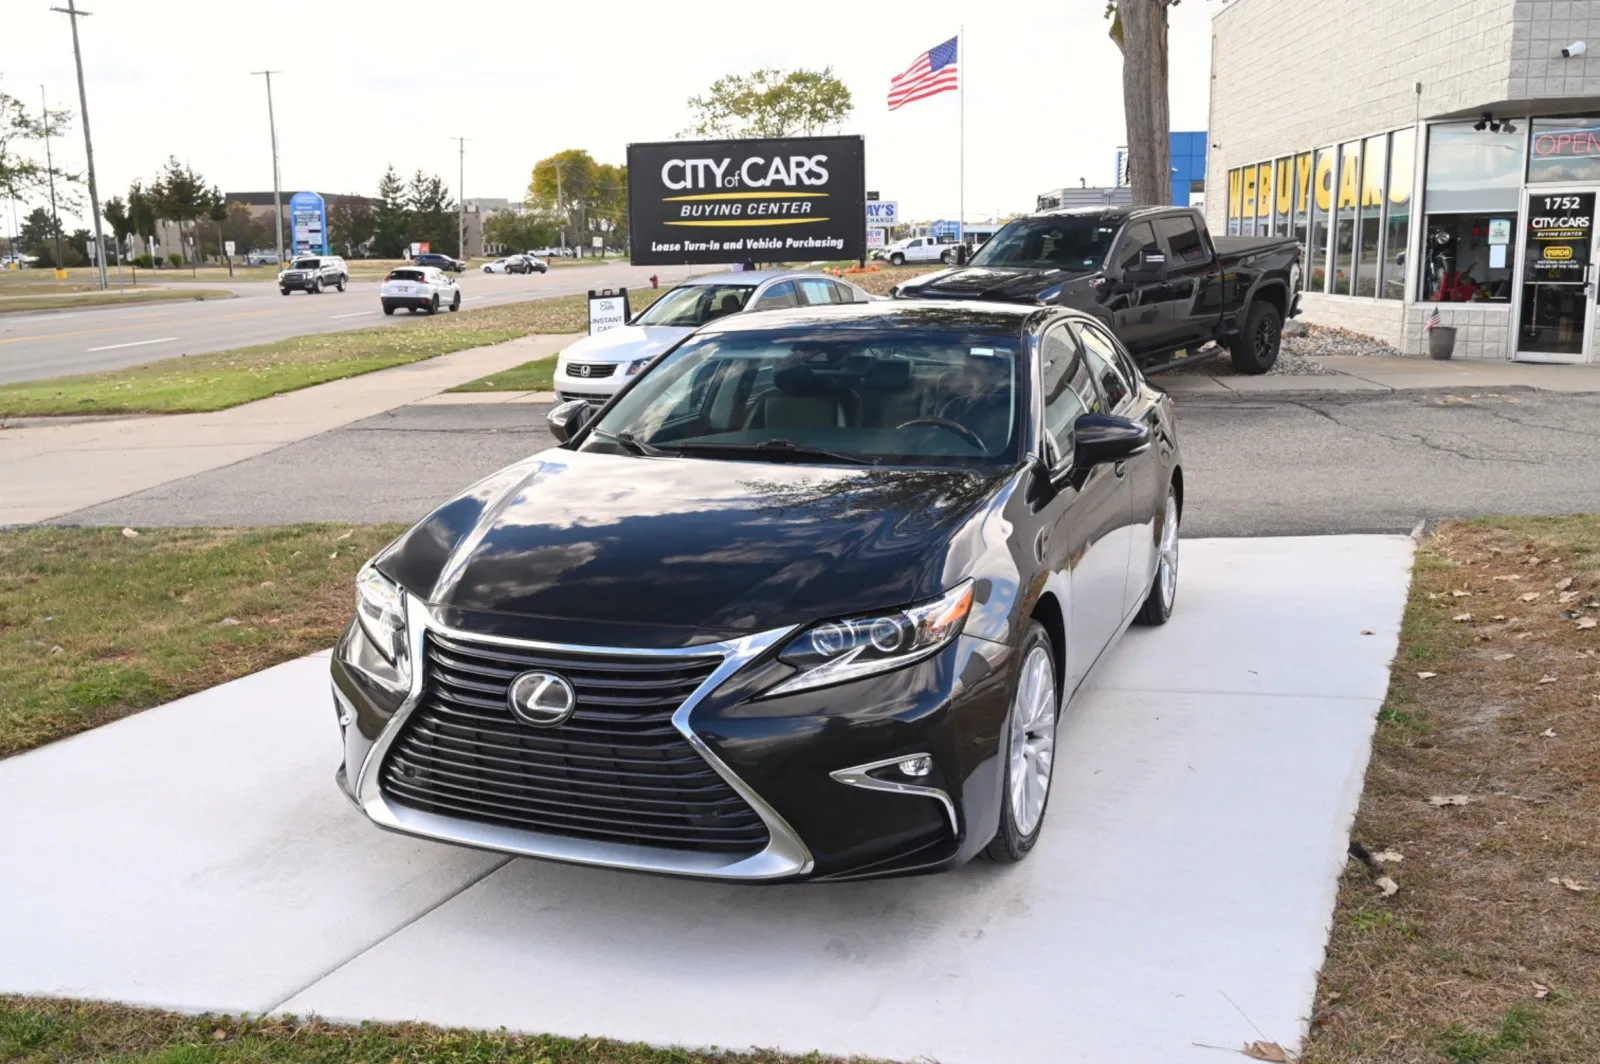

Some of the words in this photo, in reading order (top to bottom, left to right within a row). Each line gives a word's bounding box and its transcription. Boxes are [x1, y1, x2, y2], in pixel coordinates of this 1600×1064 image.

[1535, 132, 1600, 154] OPEN
[661, 158, 731, 190] CITY
[724, 170, 741, 188] of
[741, 154, 829, 188] CARS
[680, 203, 742, 217] BUYING
[747, 201, 812, 215] CENTER
[866, 203, 894, 216] AY'S
[1544, 196, 1581, 210] 1752
[1532, 217, 1557, 228] CITY
[1559, 216, 1590, 228] CARS
[651, 241, 681, 252] Lease
[723, 238, 743, 250] and
[746, 237, 783, 249] Vehicle
[786, 236, 844, 250] Purchasing
[592, 315, 622, 324] INSTANT
